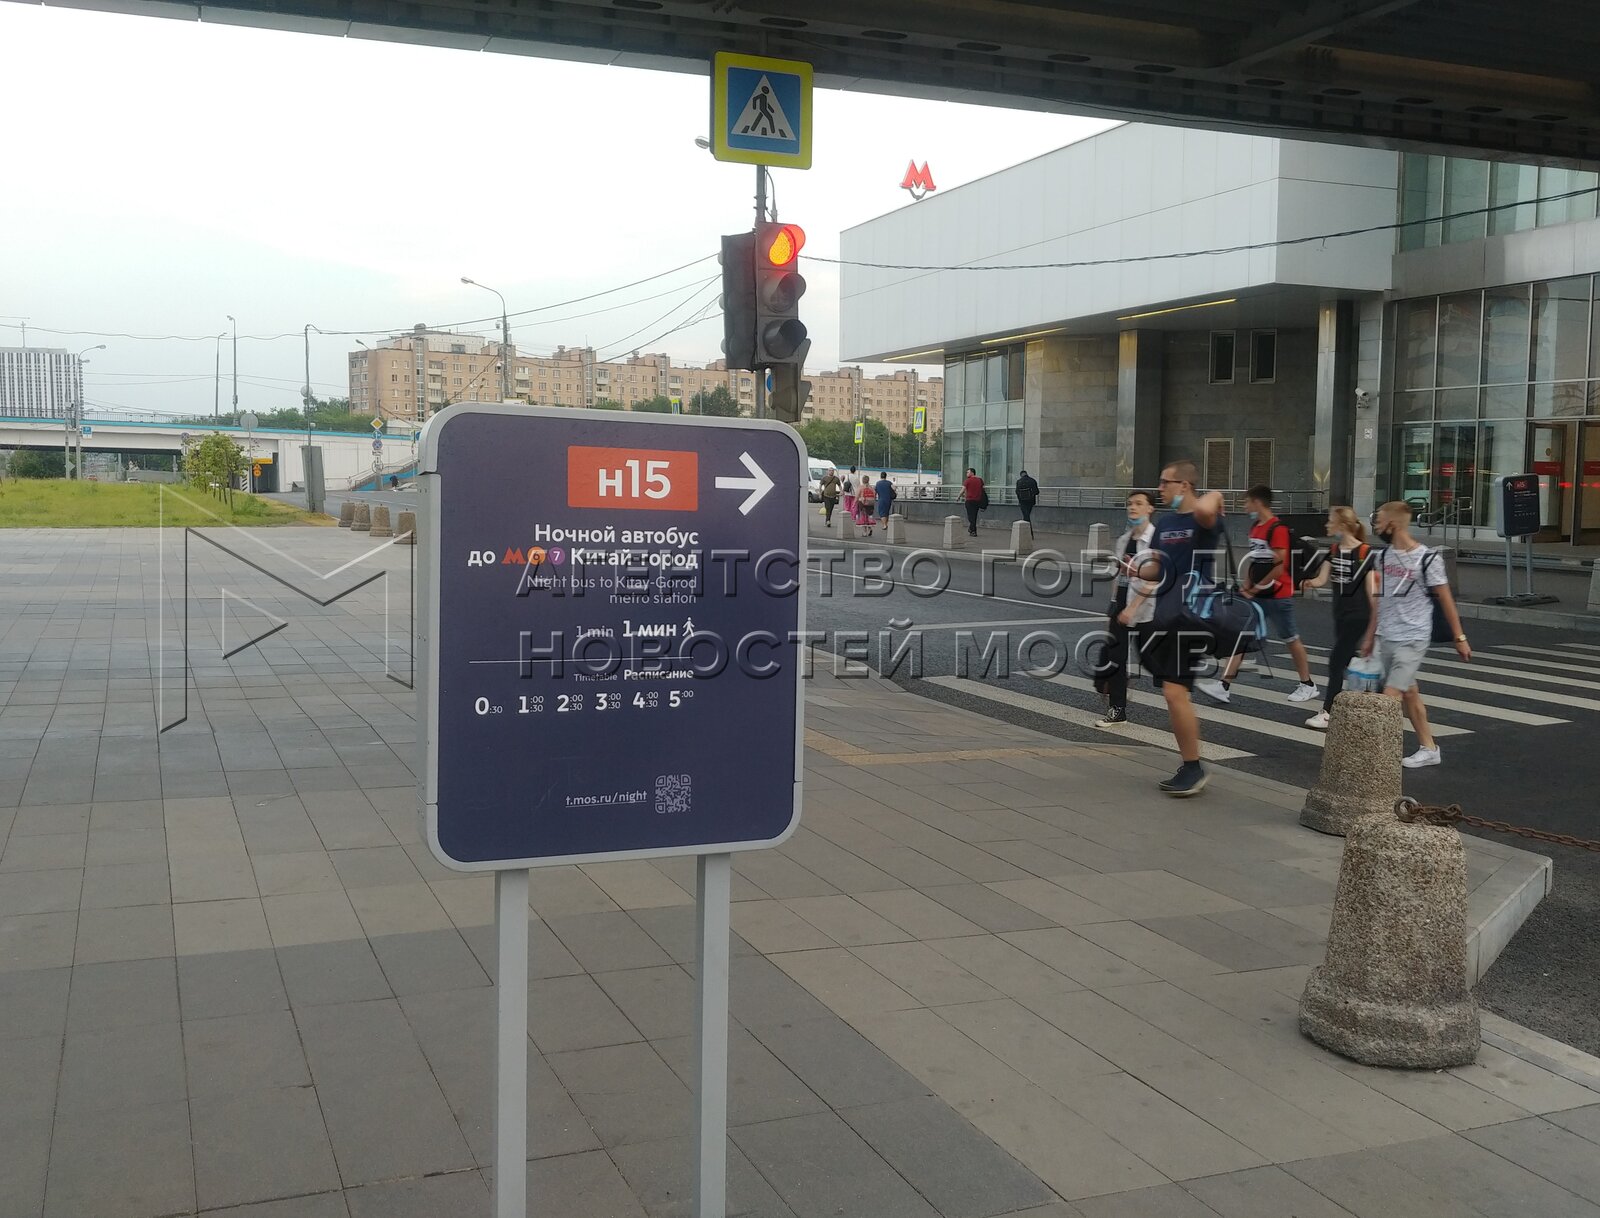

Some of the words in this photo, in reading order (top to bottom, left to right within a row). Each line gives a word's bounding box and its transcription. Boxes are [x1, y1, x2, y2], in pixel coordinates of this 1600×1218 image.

[597, 459, 672, 500] н15
[535, 523, 615, 544] Ночной
[621, 526, 699, 549] автобус
[467, 550, 496, 567] до
[571, 548, 699, 570] Китай-город
[527, 575, 567, 591] Night
[571, 575, 595, 588] bus
[599, 576, 613, 588] to
[616, 576, 697, 591] Kitay-Gorod
[609, 593, 650, 605] metro
[653, 591, 697, 605] station
[587, 625, 614, 638] min
[622, 620, 633, 637] 1
[637, 624, 677, 637] мин
[574, 673, 618, 683] Timetable
[624, 669, 694, 681] Расписание
[565, 790, 648, 806] t.mos.ru/night
